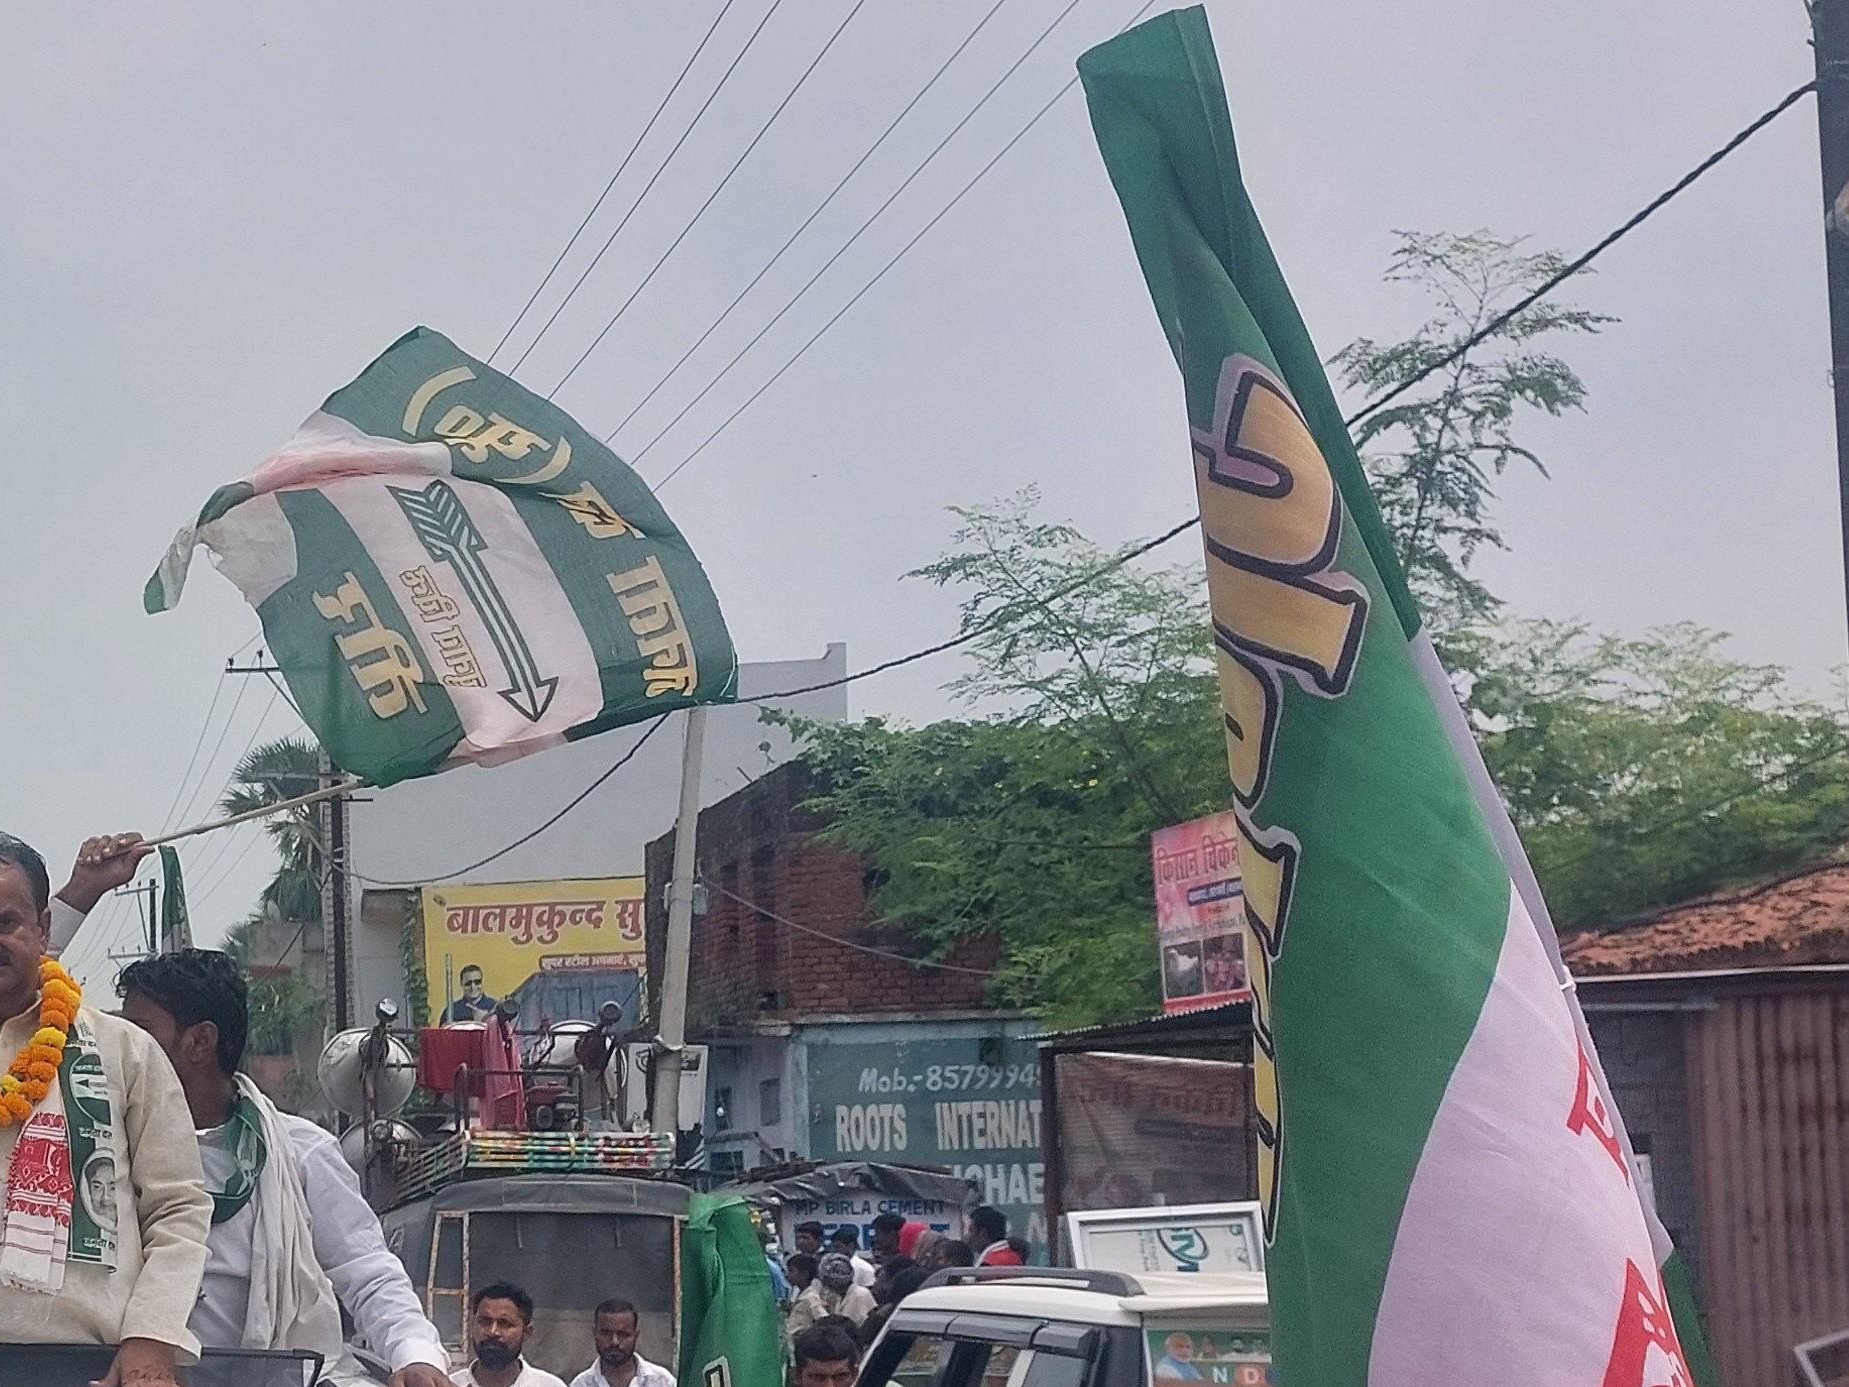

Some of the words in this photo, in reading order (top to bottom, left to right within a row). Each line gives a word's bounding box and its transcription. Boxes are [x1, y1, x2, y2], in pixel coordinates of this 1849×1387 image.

[446, 900, 606, 945] बालमुकुन्द
[836, 1103, 907, 1152] ROOTS
[934, 1099, 1043, 1150] INTERNAT
[795, 1200, 819, 1215] MP
[825, 1200, 871, 1215] BIRLA
[877, 1199, 945, 1215] CEMENT
